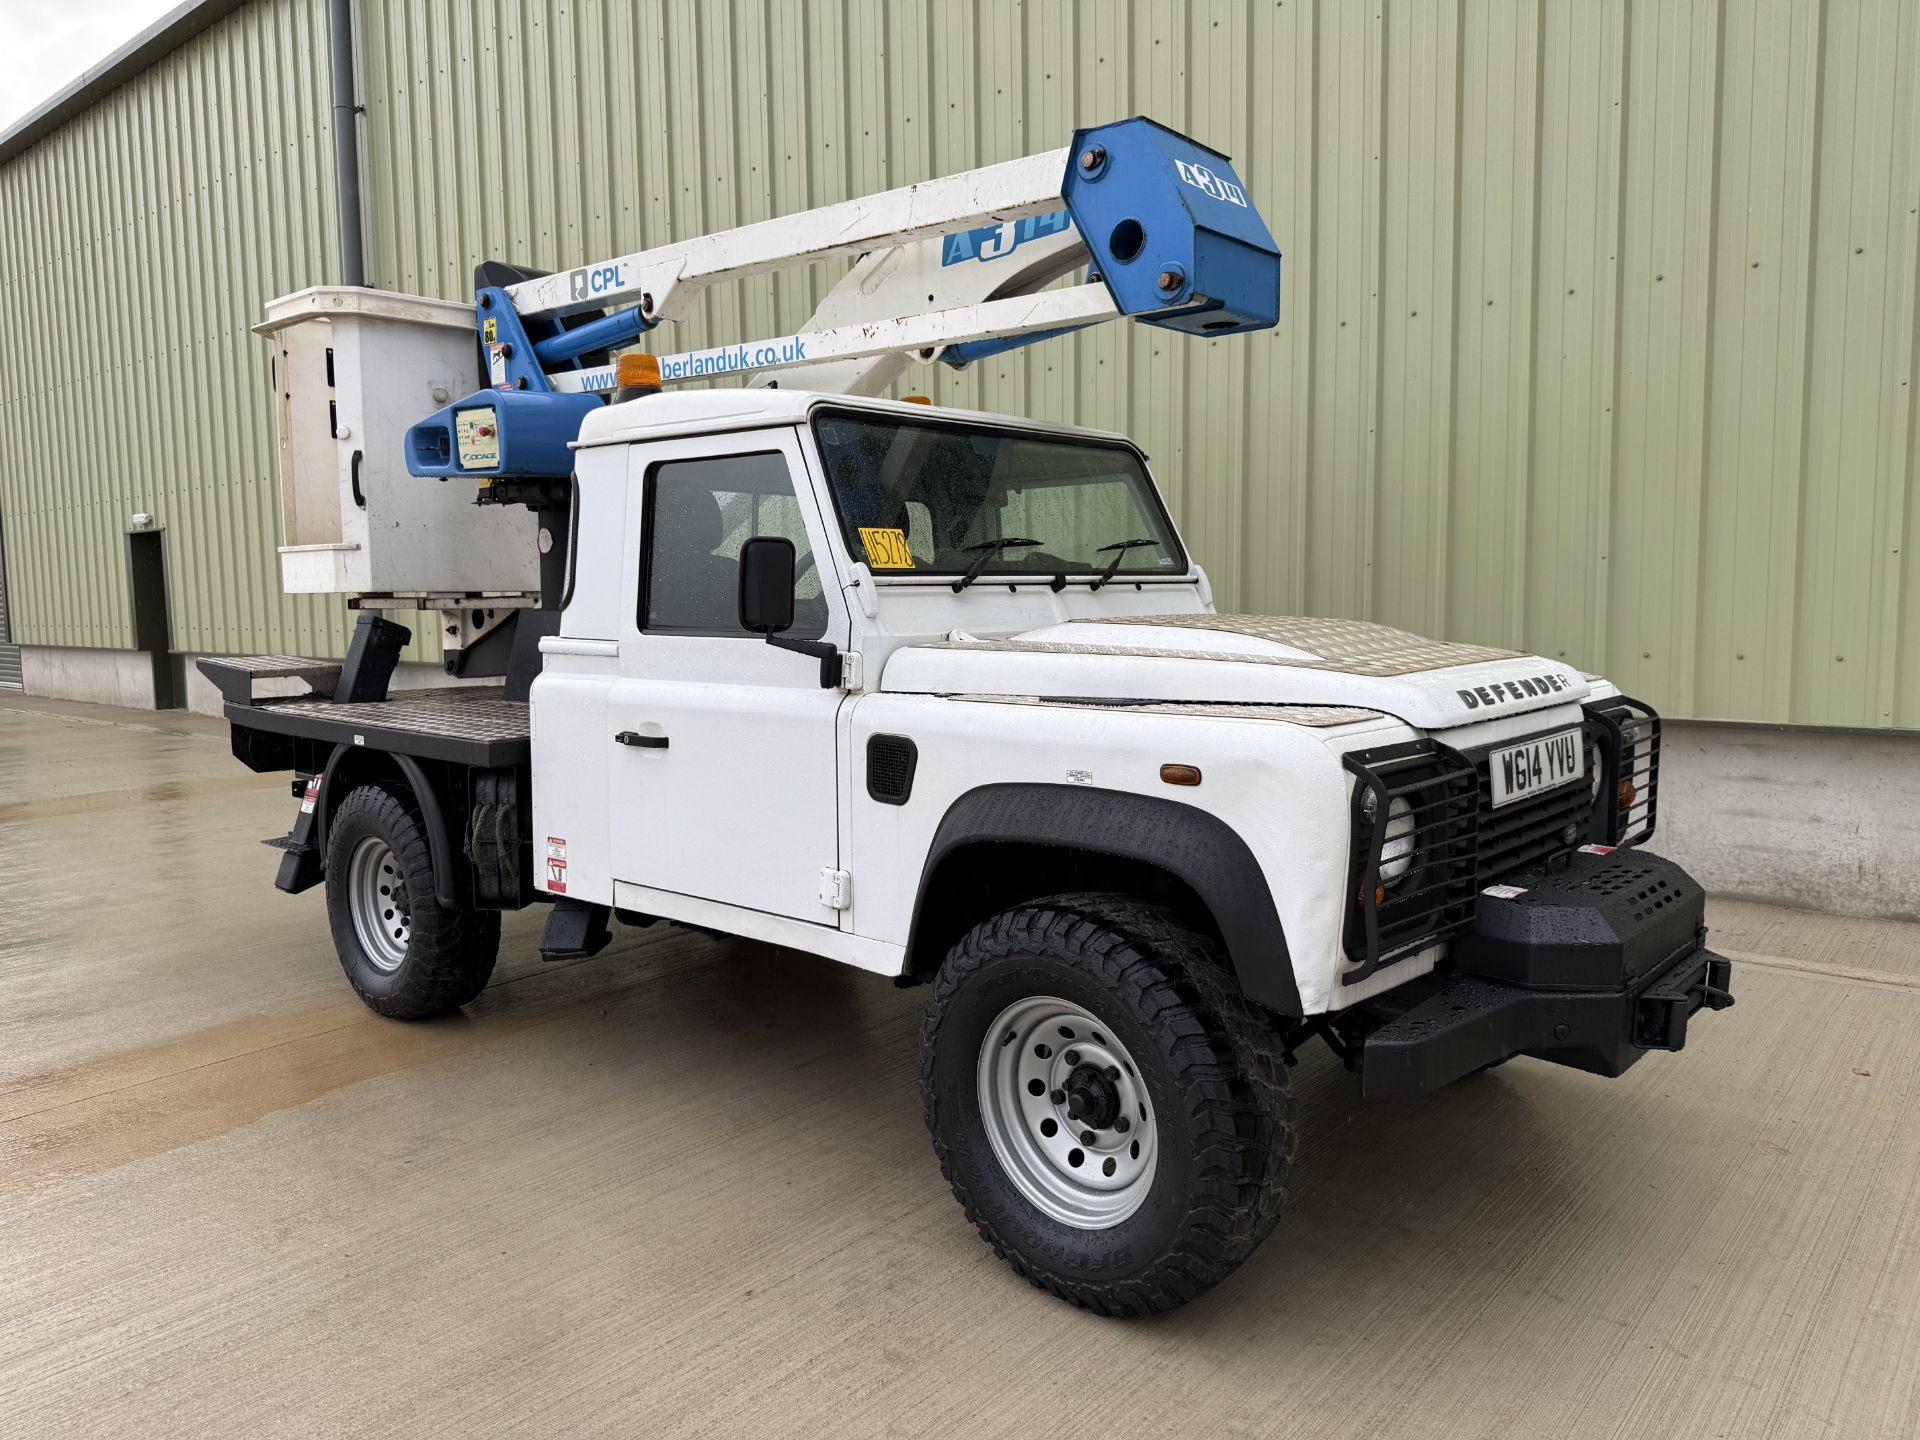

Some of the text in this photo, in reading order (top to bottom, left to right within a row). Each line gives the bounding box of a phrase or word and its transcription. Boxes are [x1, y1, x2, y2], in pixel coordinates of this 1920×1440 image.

[1175, 159, 1247, 208] A314
[591, 265, 625, 292] CPL
[1456, 674, 1571, 709] DEFENDER
[1502, 735, 1575, 795] WG14 YVU
